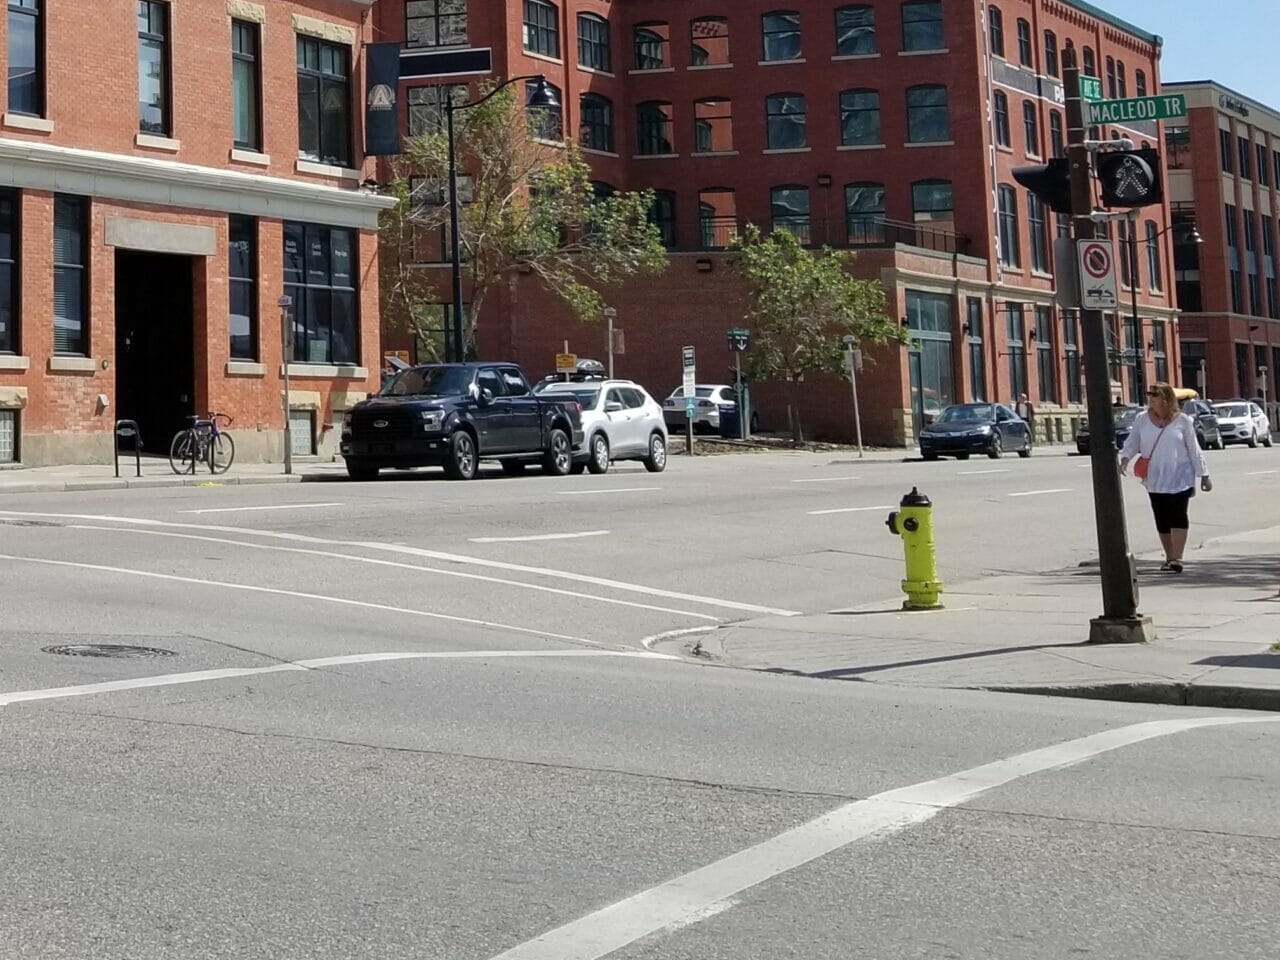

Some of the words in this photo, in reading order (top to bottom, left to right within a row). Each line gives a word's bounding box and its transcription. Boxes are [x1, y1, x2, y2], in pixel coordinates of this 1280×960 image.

[1093, 81, 1101, 99] SE
[1091, 99, 1156, 122] MACLEOD
[1163, 97, 1181, 116] TR
